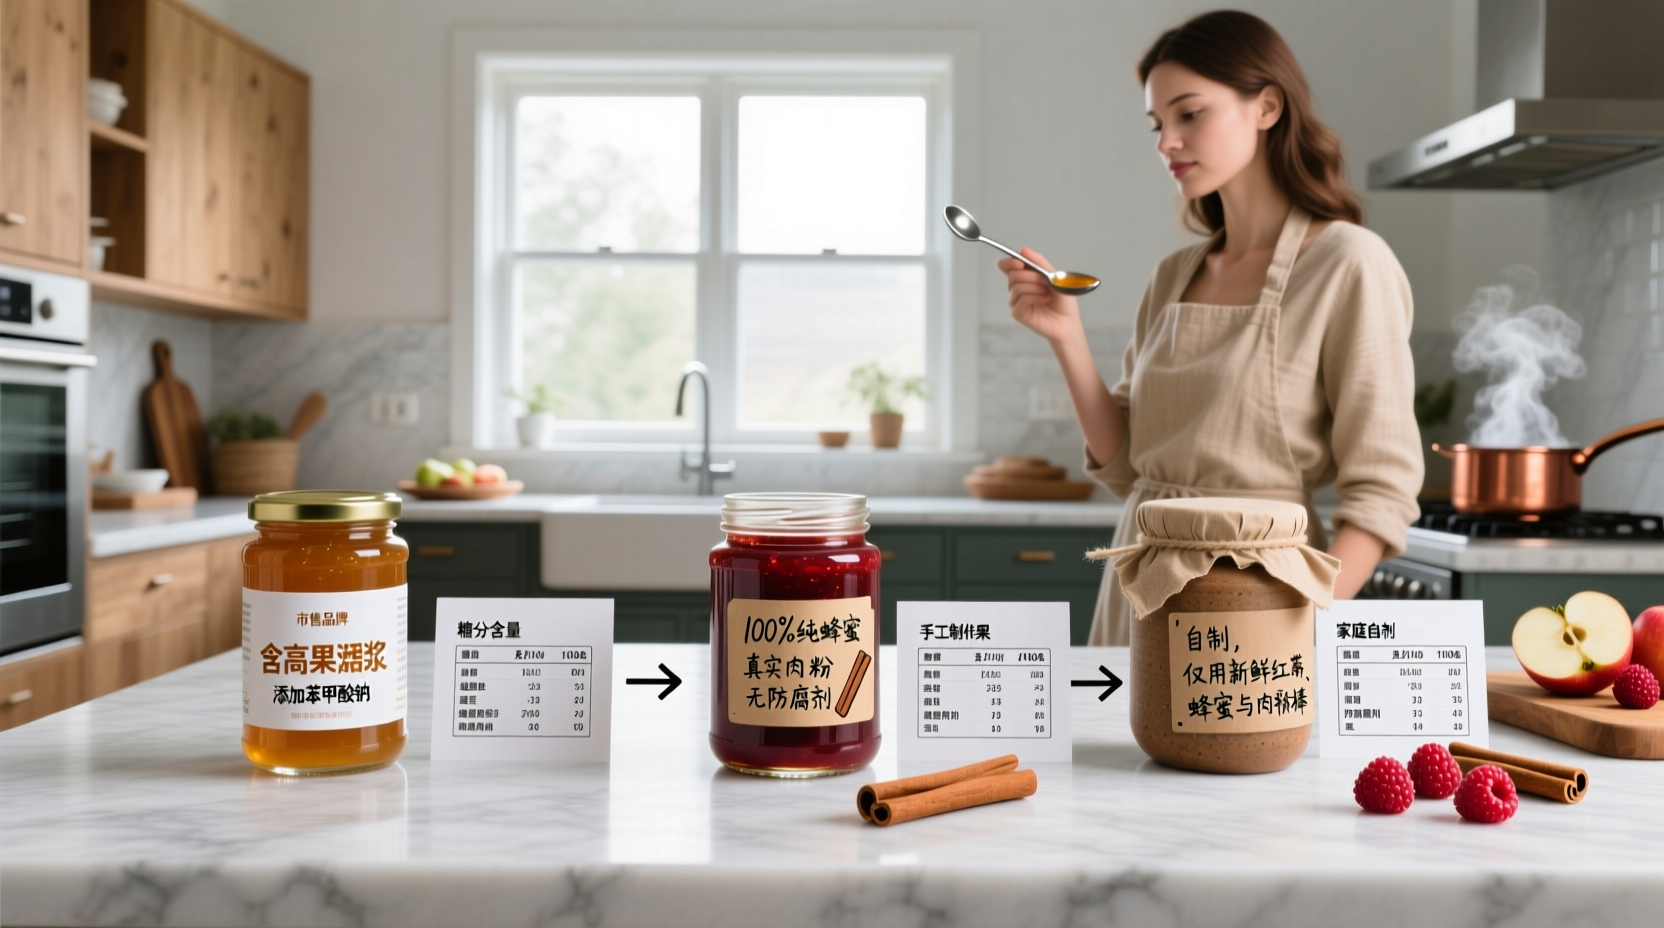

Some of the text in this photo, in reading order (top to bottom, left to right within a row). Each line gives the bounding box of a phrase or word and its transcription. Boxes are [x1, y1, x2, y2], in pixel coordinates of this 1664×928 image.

[745, 614, 861, 645] 100%纯蜂蜜
[744, 653, 834, 679] 真实肉粉
[746, 684, 831, 711] 无防腐剂
